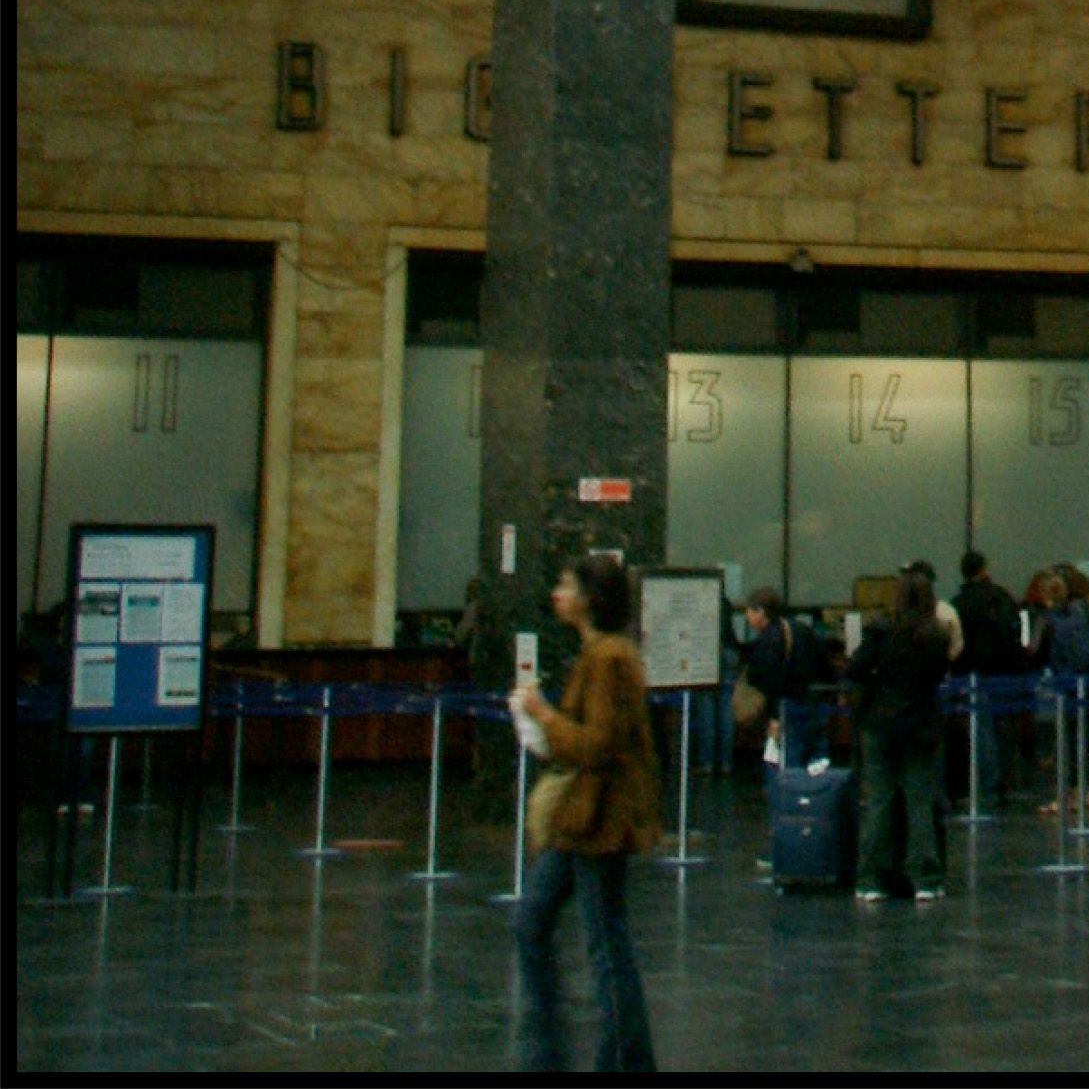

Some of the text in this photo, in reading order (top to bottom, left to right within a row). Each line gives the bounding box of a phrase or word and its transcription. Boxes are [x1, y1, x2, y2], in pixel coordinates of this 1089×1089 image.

[131, 353, 180, 435] 11
[468, 363, 482, 439] 1
[667, 370, 725, 444] 13
[849, 373, 908, 444] 14
[1028, 374, 1082, 446] 15
